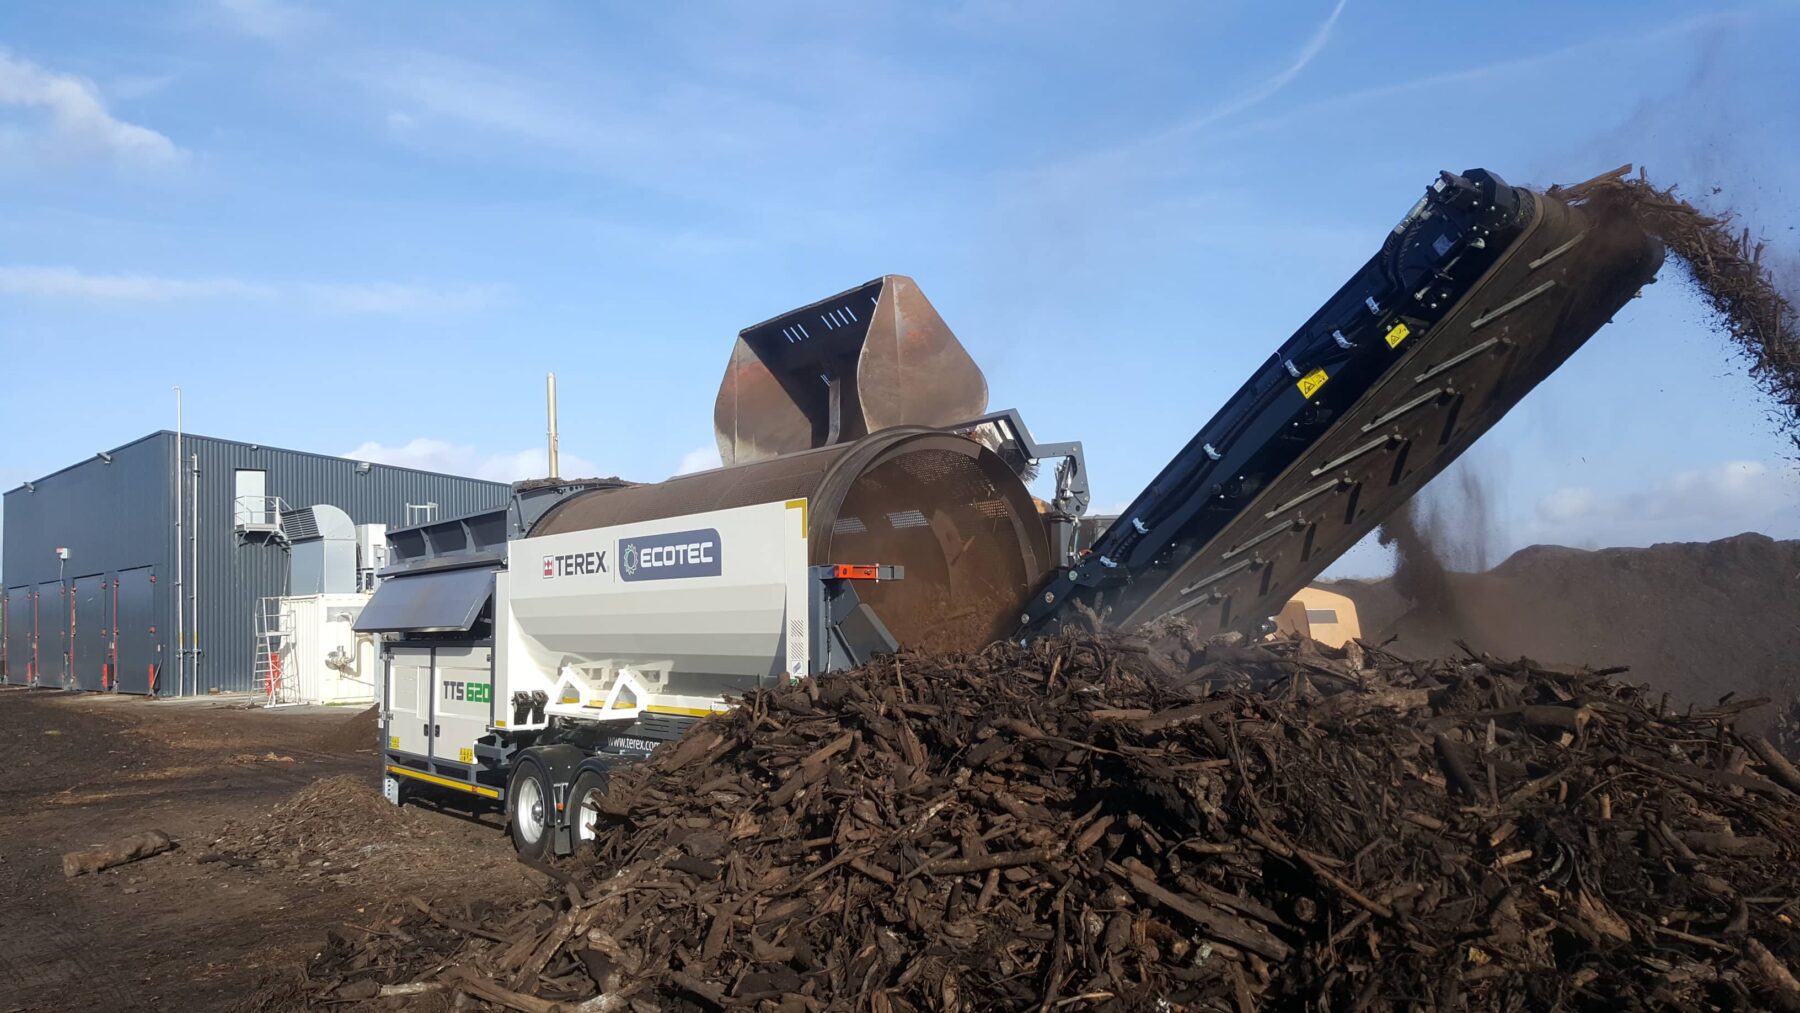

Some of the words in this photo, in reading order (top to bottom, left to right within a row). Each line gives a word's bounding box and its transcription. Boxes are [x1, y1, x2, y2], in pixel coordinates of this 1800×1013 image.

[555, 551, 607, 576] TEREX
[640, 542, 713, 568] ECOTEC
[443, 681, 465, 701] TTS
[466, 682, 492, 703] 620
